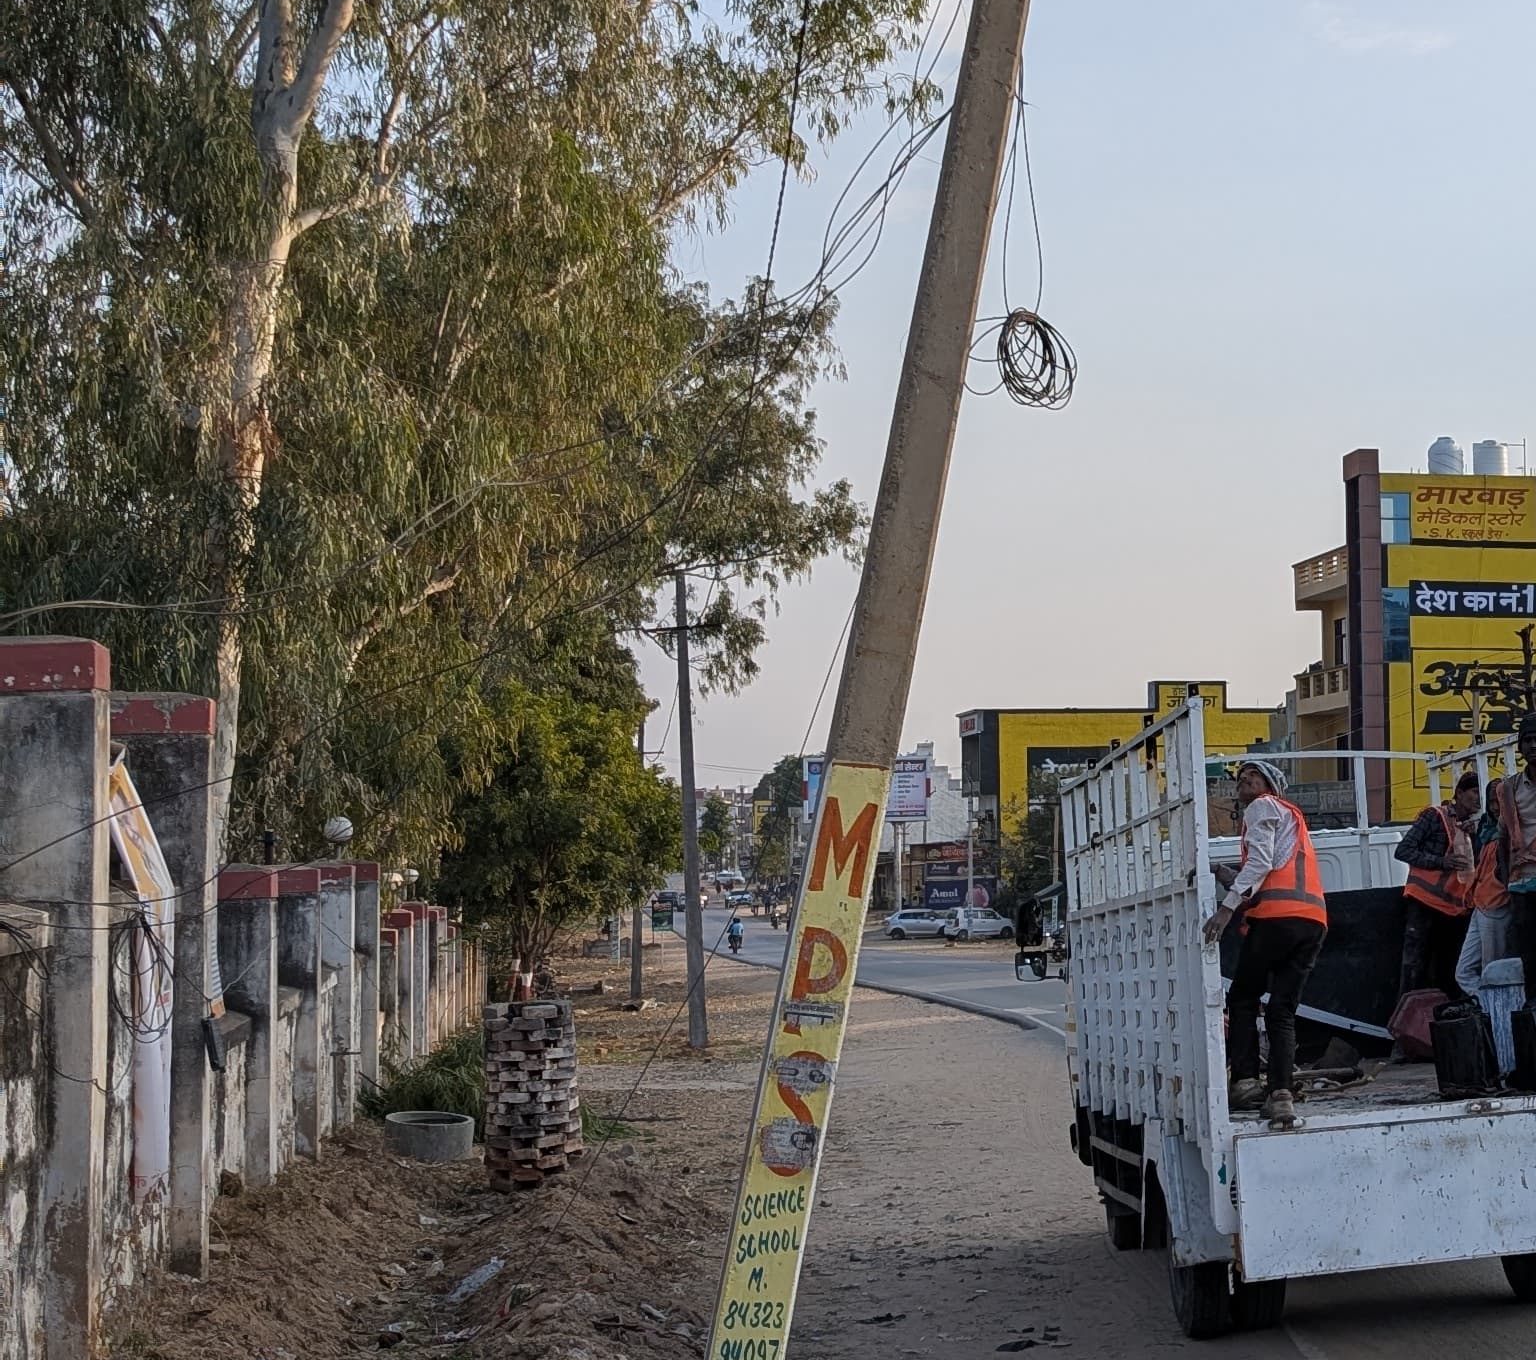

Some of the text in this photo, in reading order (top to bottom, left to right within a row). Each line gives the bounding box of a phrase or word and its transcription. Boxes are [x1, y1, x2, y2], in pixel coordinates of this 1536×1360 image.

[1416, 486, 1530, 510] मारवाड़
[1416, 507, 1527, 526] मेडिकल स्टोर
[1416, 582, 1458, 613] देश
[1463, 591, 1496, 612] का
[930, 887, 958, 898] Amul
[740, 1186, 805, 1226] SCIENCE
[736, 1226, 800, 1264] SCHOOL
[748, 1267, 768, 1293] M.
[723, 1300, 784, 1329] 84323
